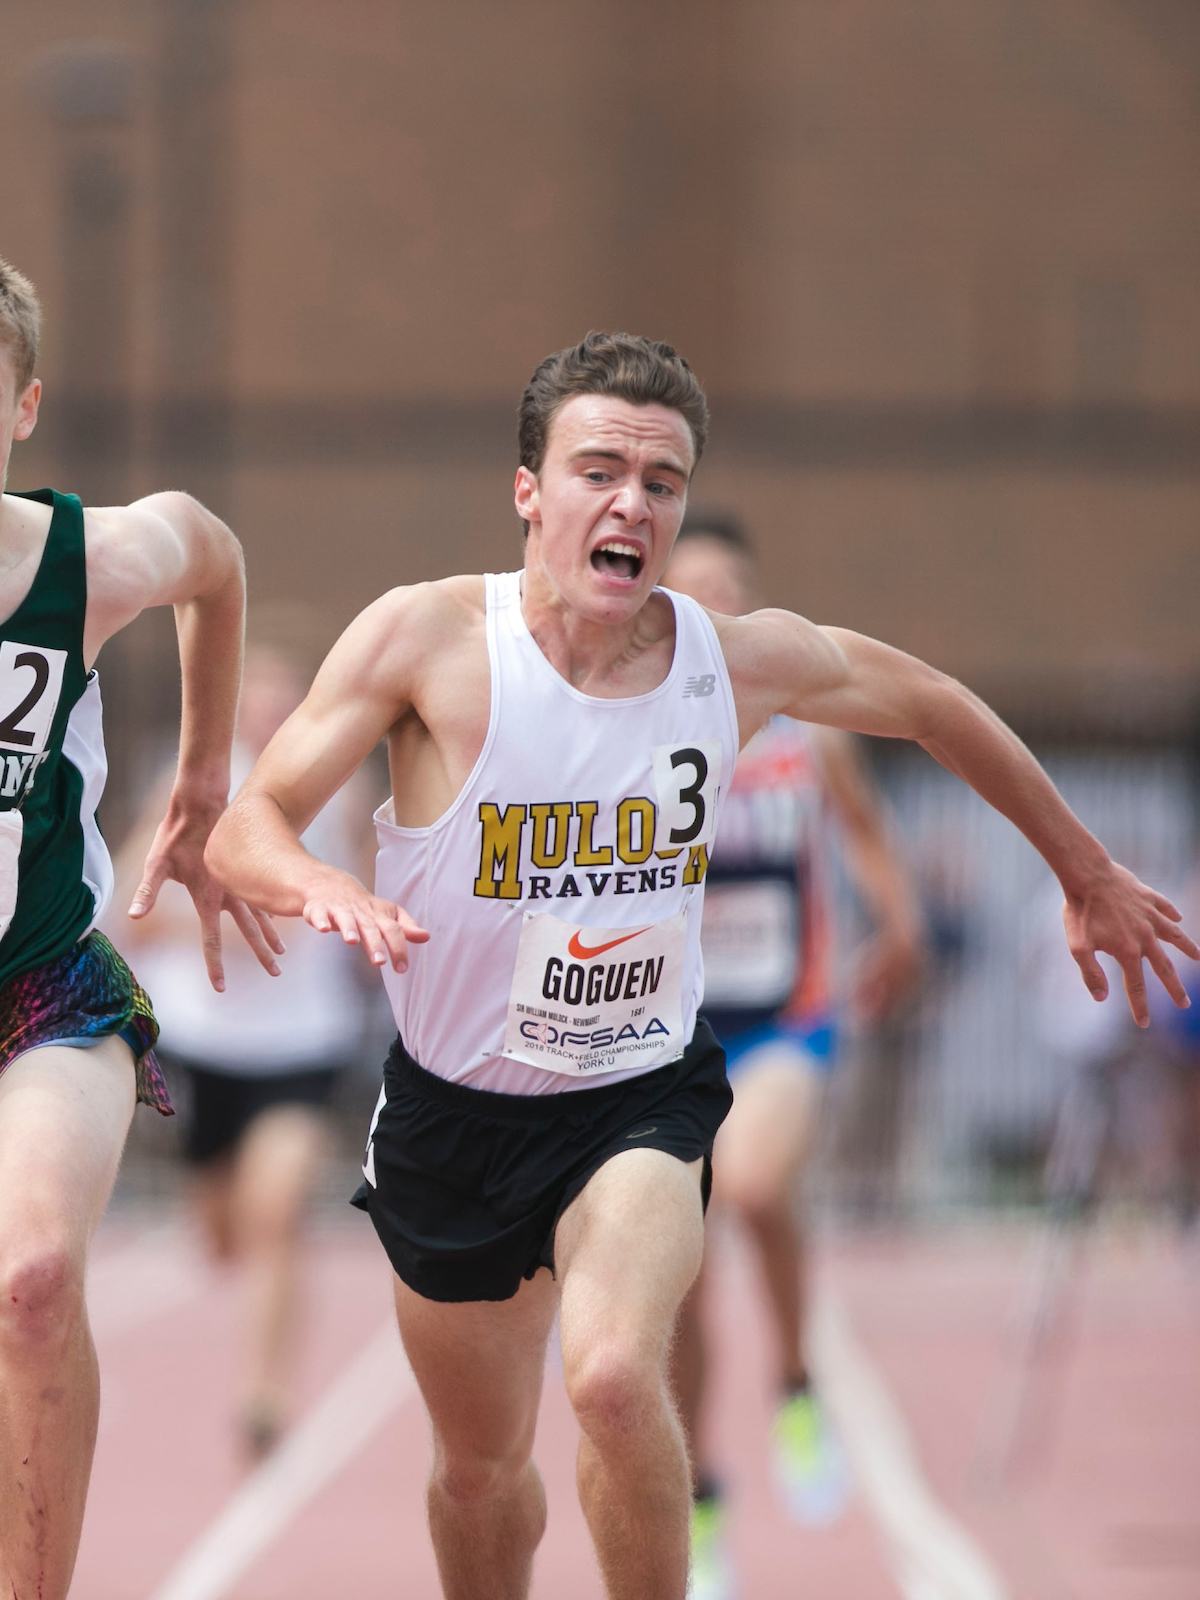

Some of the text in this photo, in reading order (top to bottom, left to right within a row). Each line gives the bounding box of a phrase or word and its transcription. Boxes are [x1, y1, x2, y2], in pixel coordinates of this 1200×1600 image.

[669, 747, 708, 844] 3
[473, 796, 709, 900] MULO
[527, 865, 677, 900] RAVENS
[542, 955, 665, 1007] GOGUEN
[516, 1003, 525, 1013] SIR
[526, 1005, 547, 1019] WILLIAM
[548, 1011, 568, 1024] MULOCK
[573, 1015, 600, 1027] NEWMARKET
[524, 1041, 544, 1051] 2018
[600, 1040, 666, 1057] CHAMPIONSHIPS
[577, 1056, 615, 1071] YORK U
